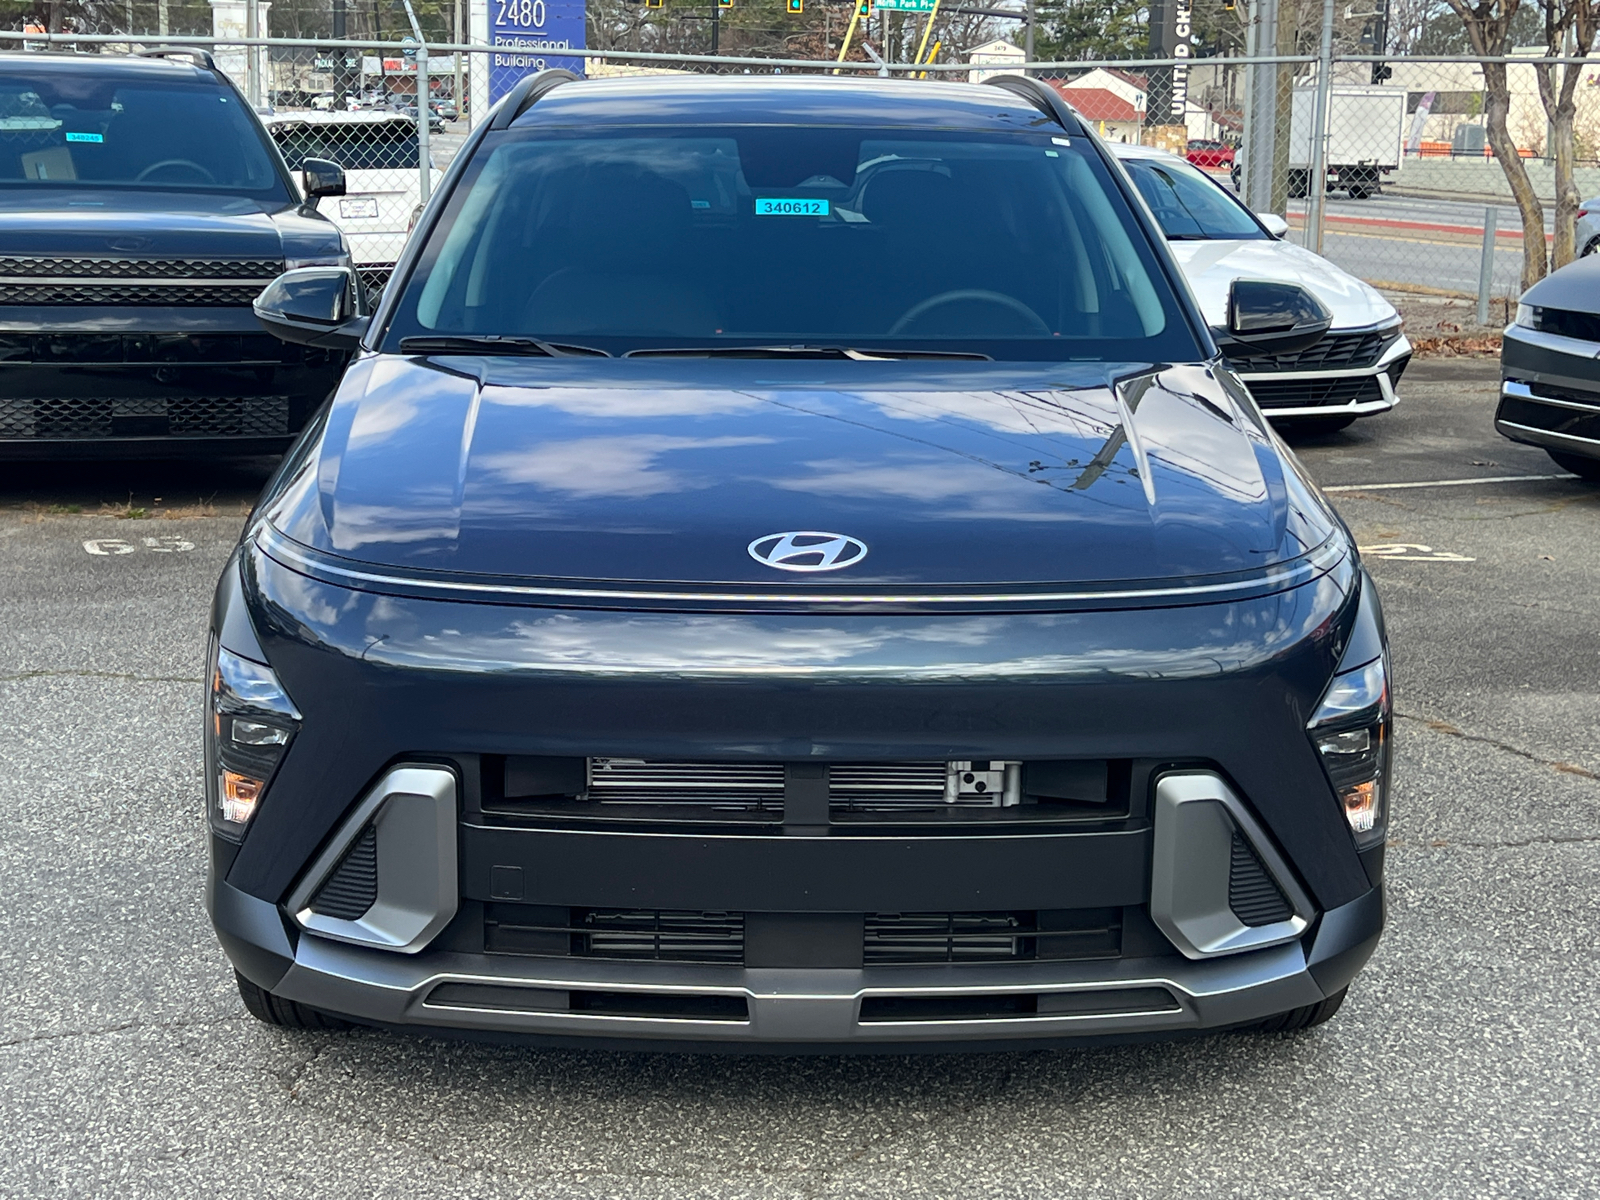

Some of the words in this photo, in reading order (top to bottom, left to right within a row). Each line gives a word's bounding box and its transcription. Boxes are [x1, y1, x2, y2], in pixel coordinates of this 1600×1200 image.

[495, 0, 546, 28] 2480
[494, 36, 569, 51] Professional
[494, 53, 546, 71] Building
[763, 202, 821, 214] 340612
